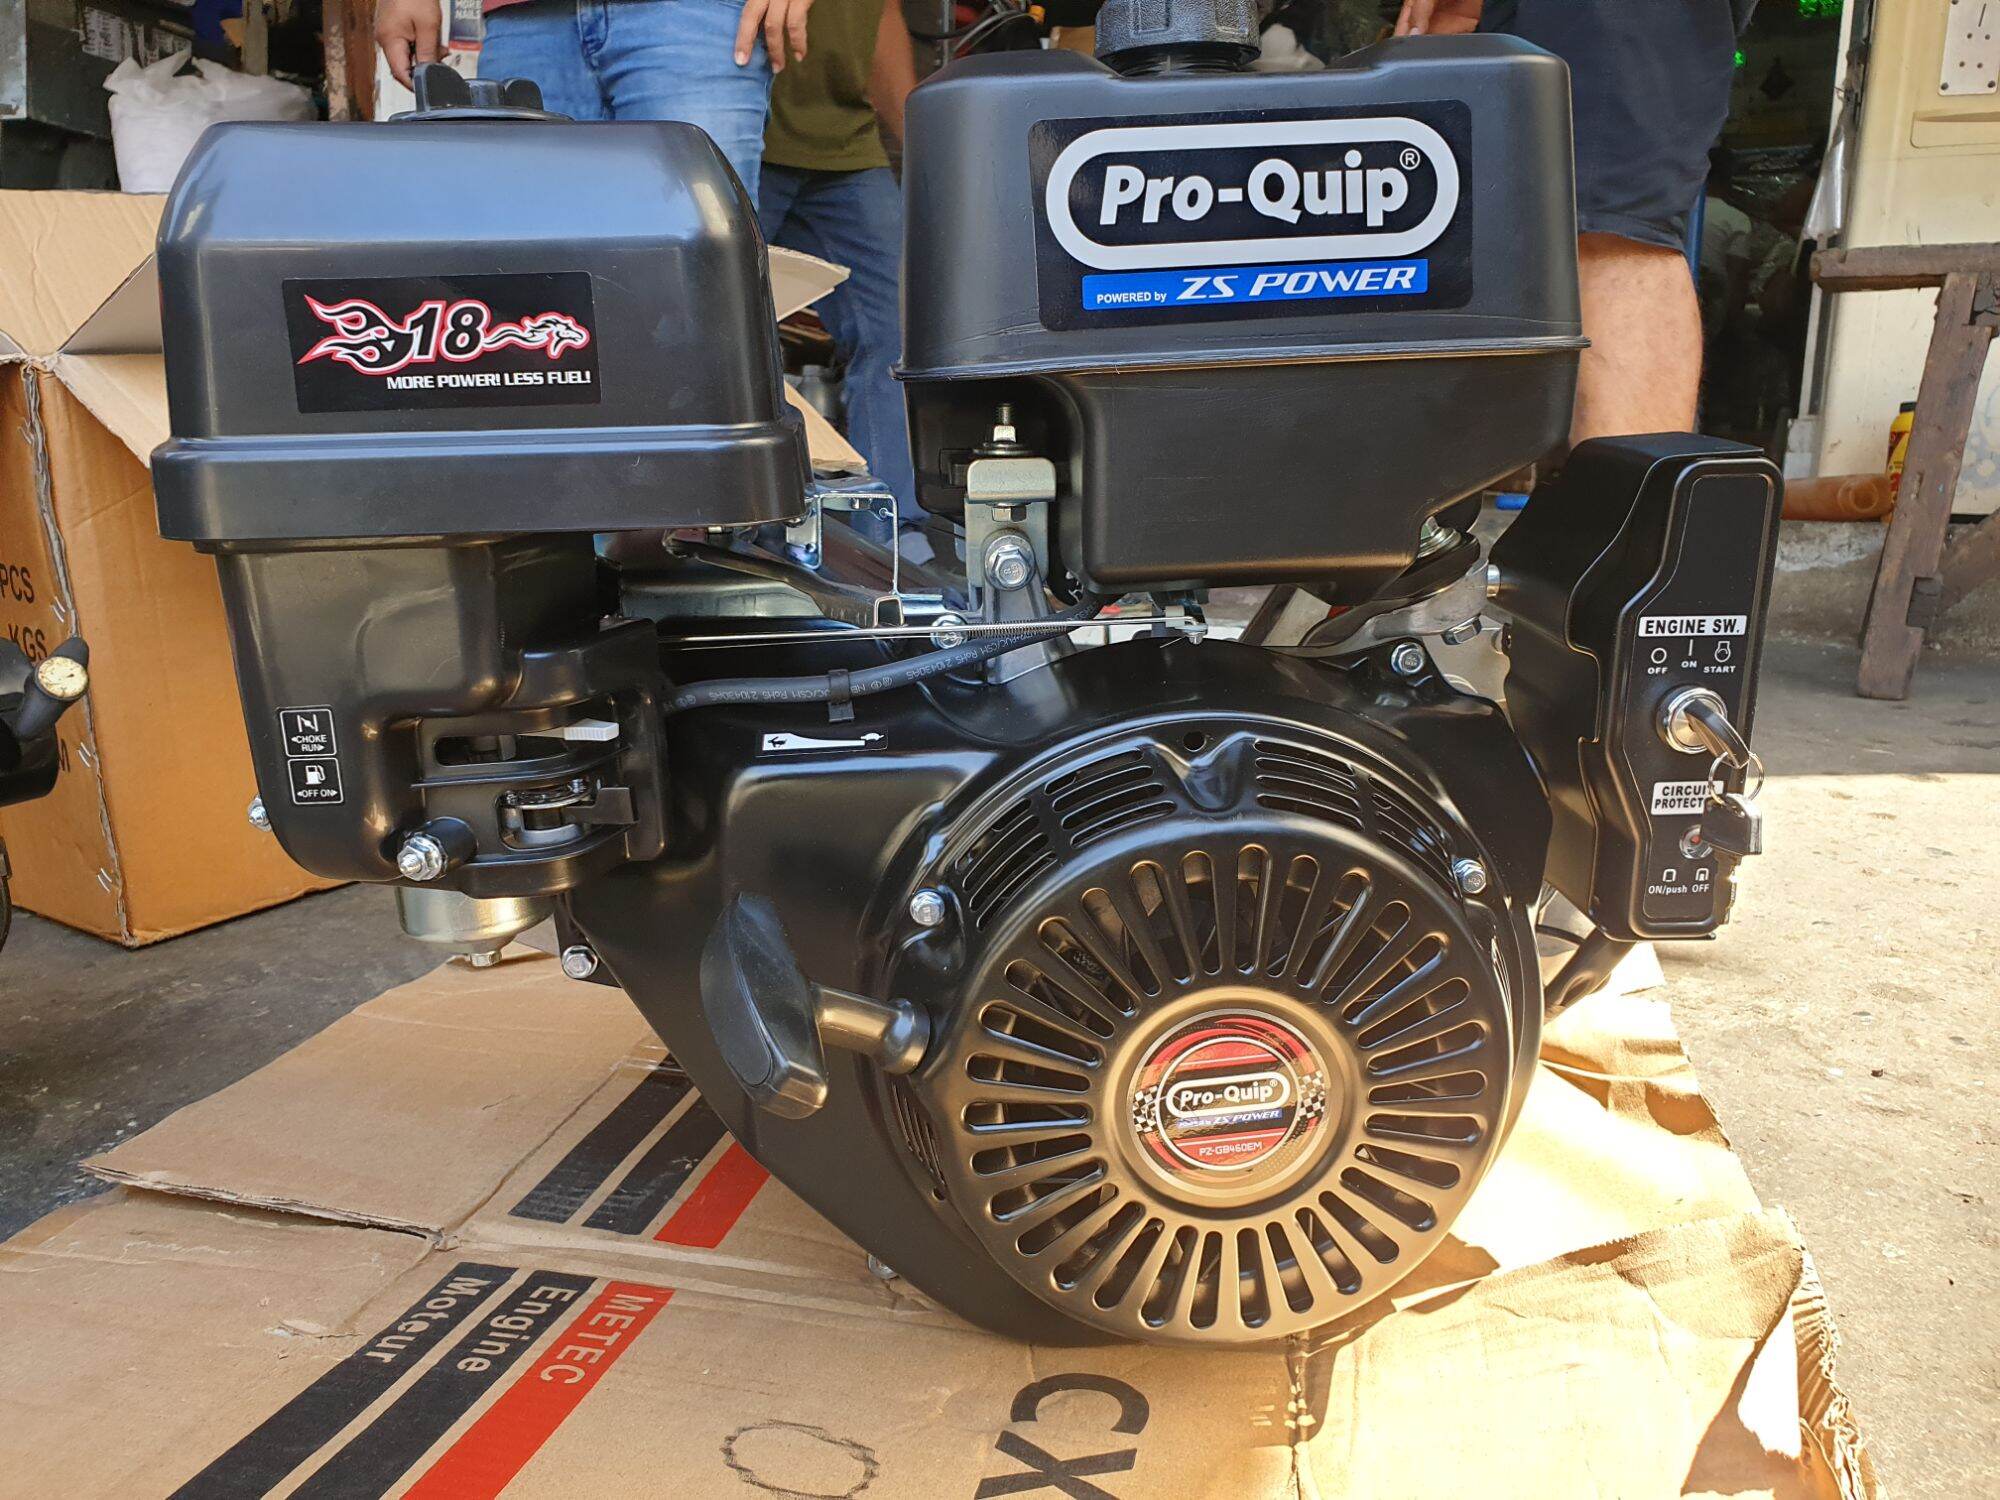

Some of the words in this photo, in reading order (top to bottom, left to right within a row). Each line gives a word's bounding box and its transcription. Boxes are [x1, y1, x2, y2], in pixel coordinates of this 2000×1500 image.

[1096, 292, 1152, 305] POWERED
[1154, 291, 1168, 304] by
[1176, 274, 1239, 301] ZS
[1249, 266, 1416, 297] POWER
[387, 374, 435, 390] MORE
[437, 372, 501, 389] POWER!
[504, 371, 544, 386] LESS
[547, 370, 591, 385] FUEL!
[0, 563, 35, 604] PCS
[1645, 619, 1706, 634] ENGINE
[1712, 618, 1740, 634] SW.
[1681, 660, 1698, 668] ON
[1703, 665, 1736, 673] START
[1647, 666, 1669, 675] OFF
[296, 734, 327, 744] CHOKE
[301, 744, 321, 752] RUN
[302, 789, 319, 798] OFF
[320, 789, 333, 797] ON
[1655, 797, 1704, 809] PROTECT
[1648, 884, 1688, 896] ON/push
[1691, 883, 1710, 893] OFF
[1232, 1110, 1280, 1122] POWER
[366, 1276, 491, 1364] Moteur
[456, 1285, 578, 1372] Engine
[540, 1292, 654, 1384] METEC
